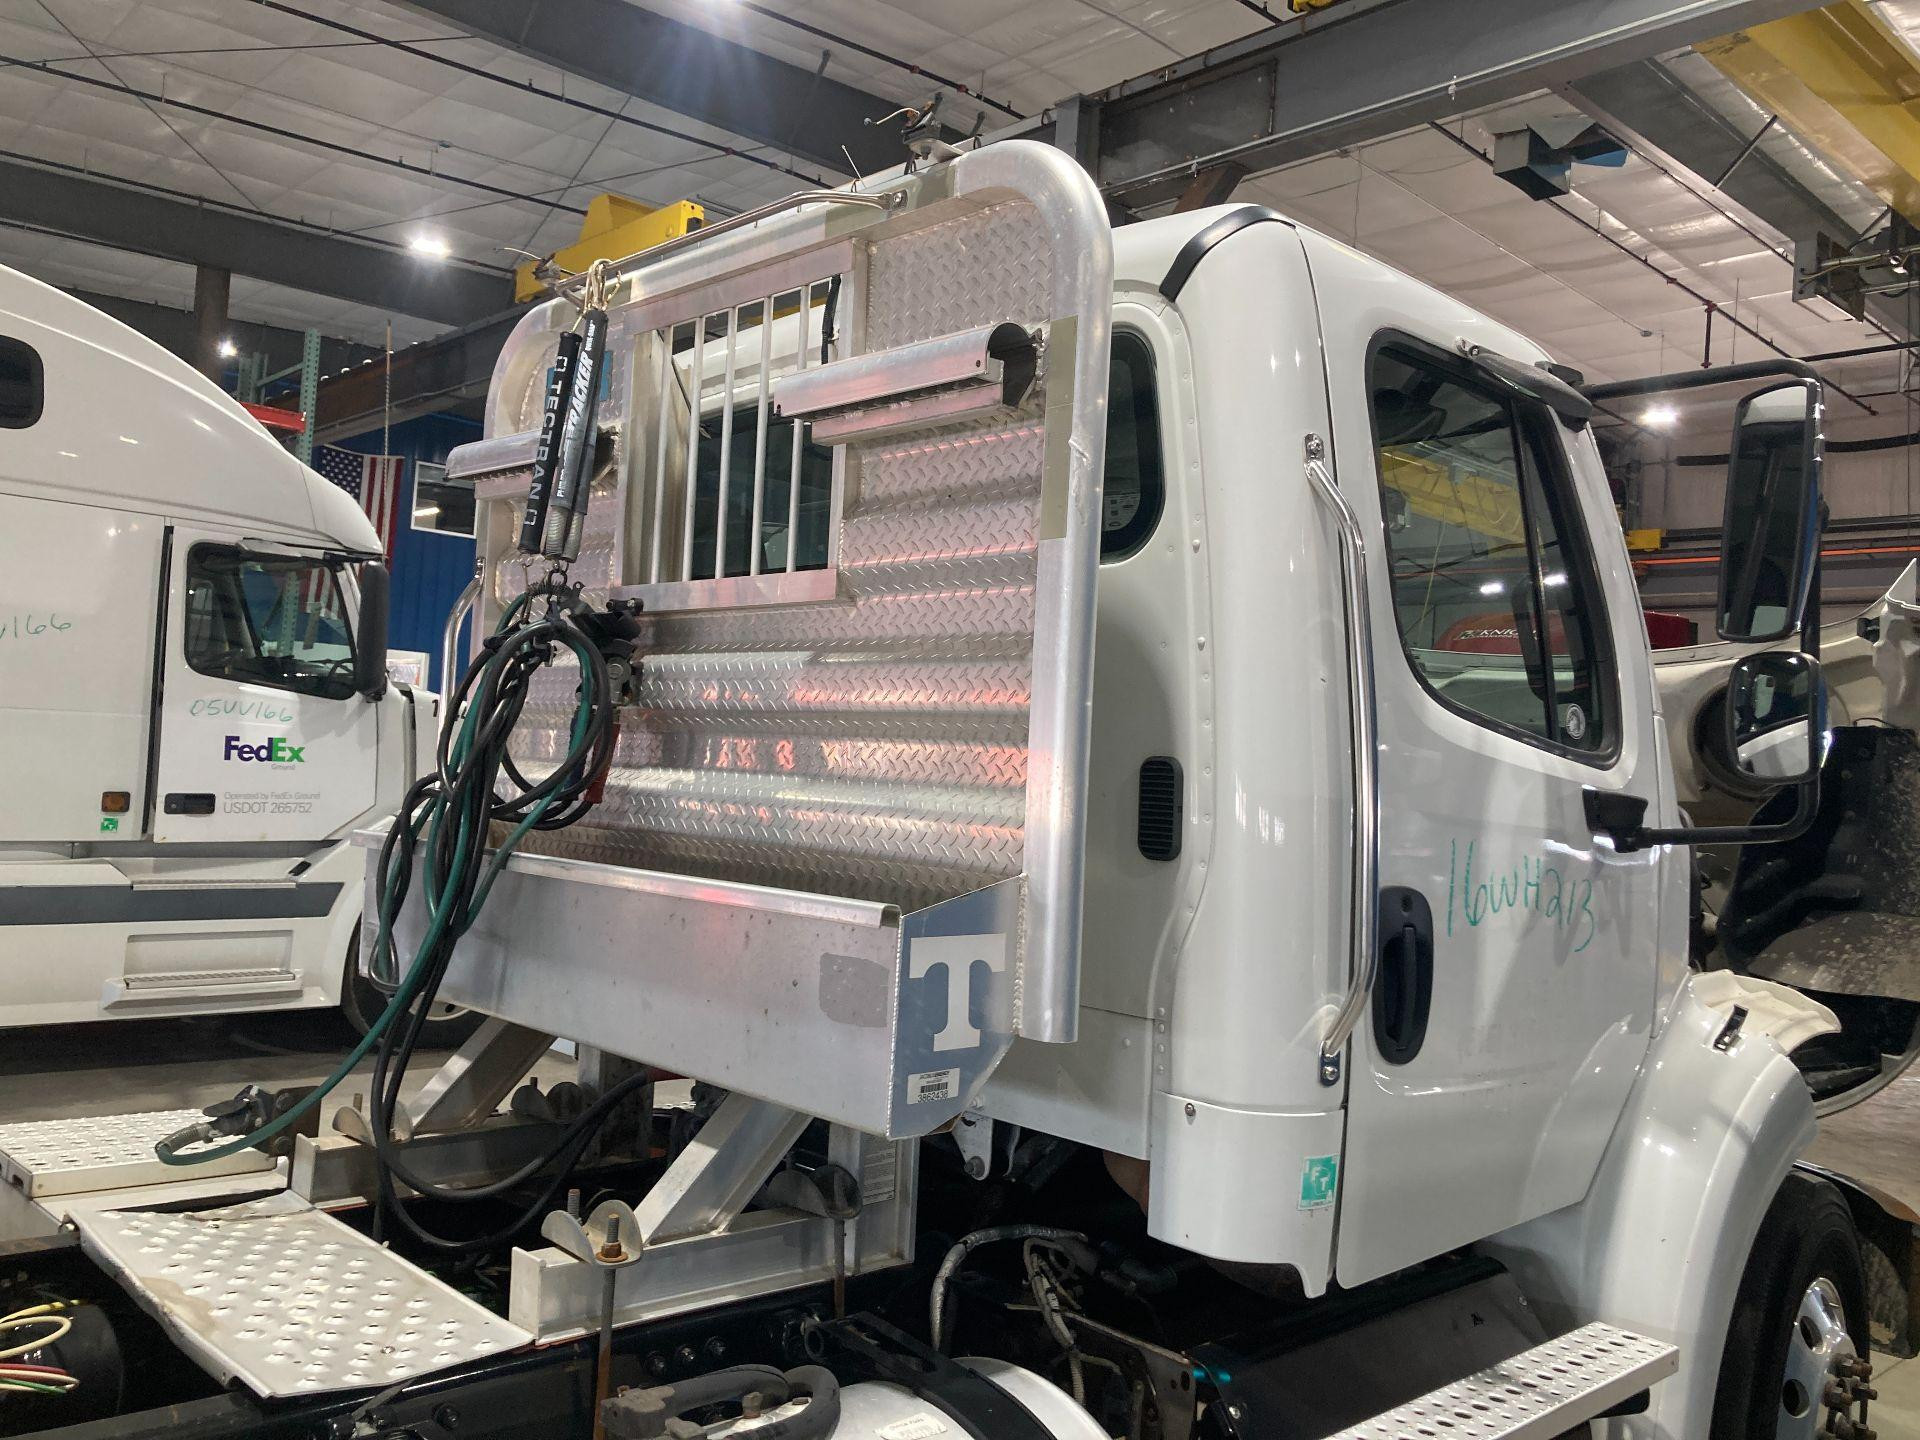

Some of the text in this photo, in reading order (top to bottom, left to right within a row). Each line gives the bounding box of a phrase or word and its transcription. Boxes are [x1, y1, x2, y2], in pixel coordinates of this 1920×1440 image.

[529, 381, 562, 500] TECTRAN
[224, 735, 305, 763] FedEx
[224, 802, 312, 814] USDOT 265752
[909, 933, 1006, 1052] T
